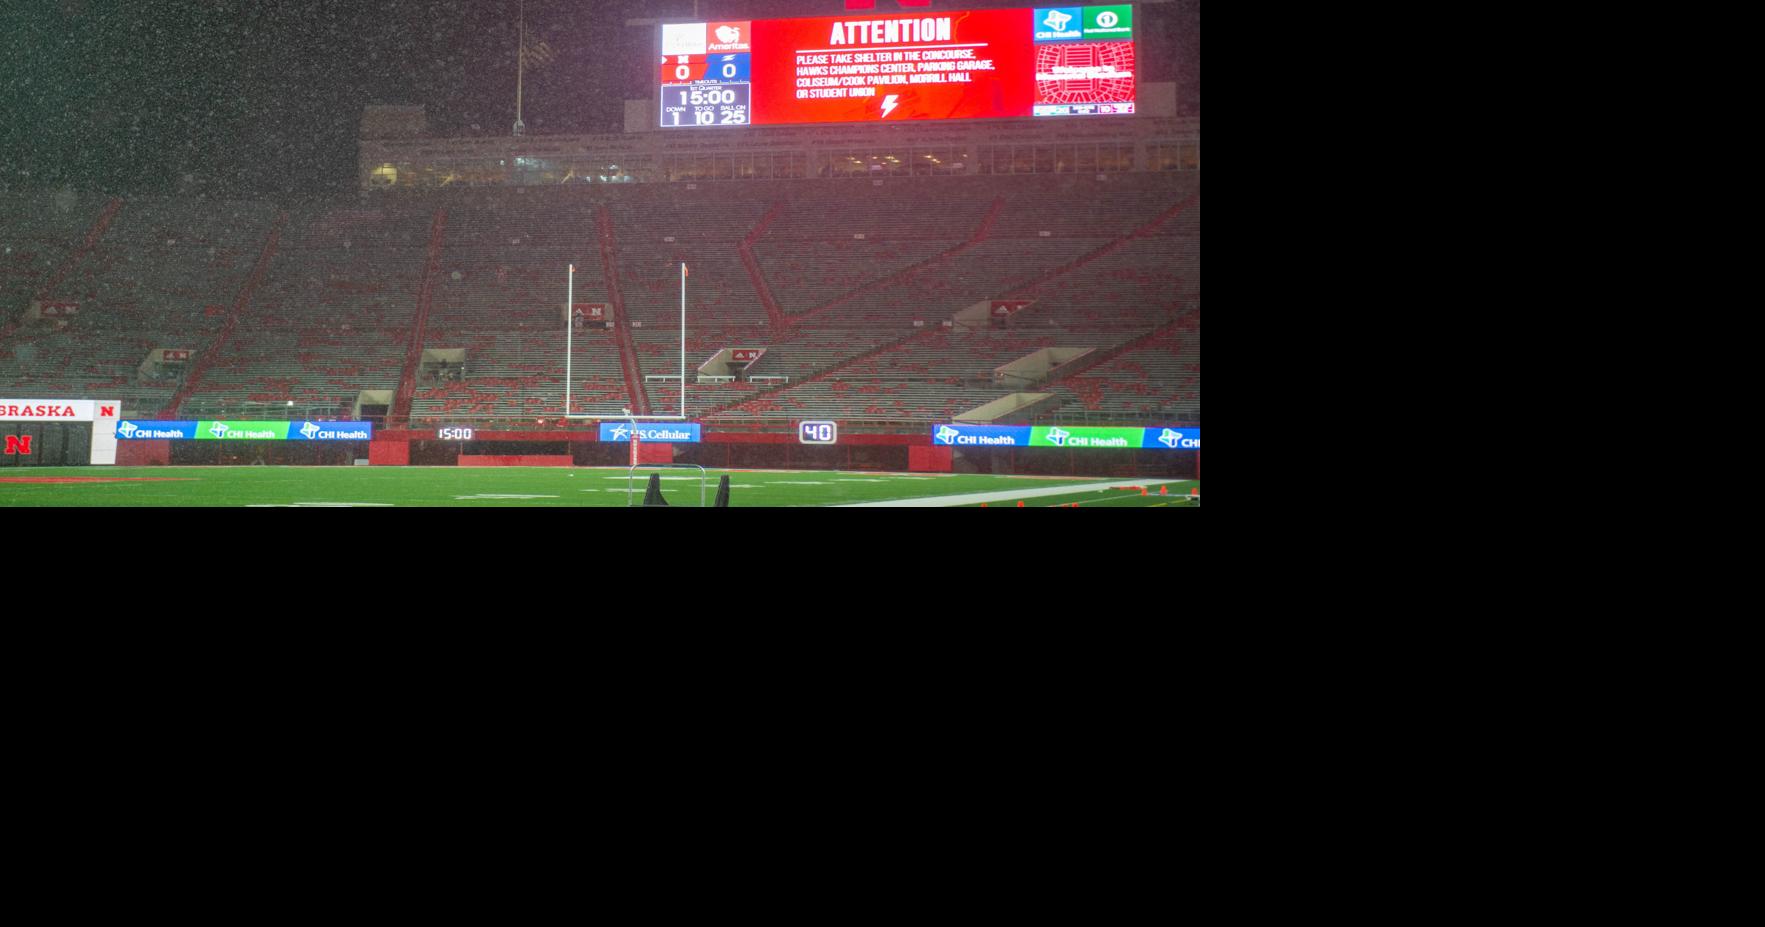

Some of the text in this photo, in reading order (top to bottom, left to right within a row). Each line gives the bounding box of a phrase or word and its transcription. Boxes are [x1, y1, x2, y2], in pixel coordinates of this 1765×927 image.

[830, 17, 951, 45] ATTENTION
[796, 54, 828, 64] PLEASE
[830, 54, 852, 64] TAKE
[854, 52, 892, 62] SHELTER
[894, 52, 902, 62] IN
[904, 51, 921, 60] THE
[676, 65, 690, 80] 0
[722, 64, 736, 78] 0
[796, 66, 828, 76] HAWKS
[830, 64, 879, 75] CHAMPIONS
[918, 62, 956, 72] PARKING
[796, 76, 866, 88] COLISEUM/COOK
[910, 73, 946, 84] MORRILL
[948, 72, 972, 82] HALL
[680, 90, 735, 105] 15:00
[796, 87, 876, 99] OR STUDENT UNION
[672, 112, 680, 126] 1
[694, 112, 714, 126] 10
[720, 110, 746, 124] 25
[100, 406, 114, 416] N
[136, 430, 184, 438] CHI Health
[227, 430, 275, 438] CHI Health
[318, 430, 368, 439] CHI Health
[439, 428, 472, 440] 15:00
[648, 430, 691, 440] Cellular
[805, 424, 832, 440] 40
[4, 435, 32, 454] N
[958, 436, 1015, 444] CHI Health
[1068, 437, 1128, 446] CHI Health
